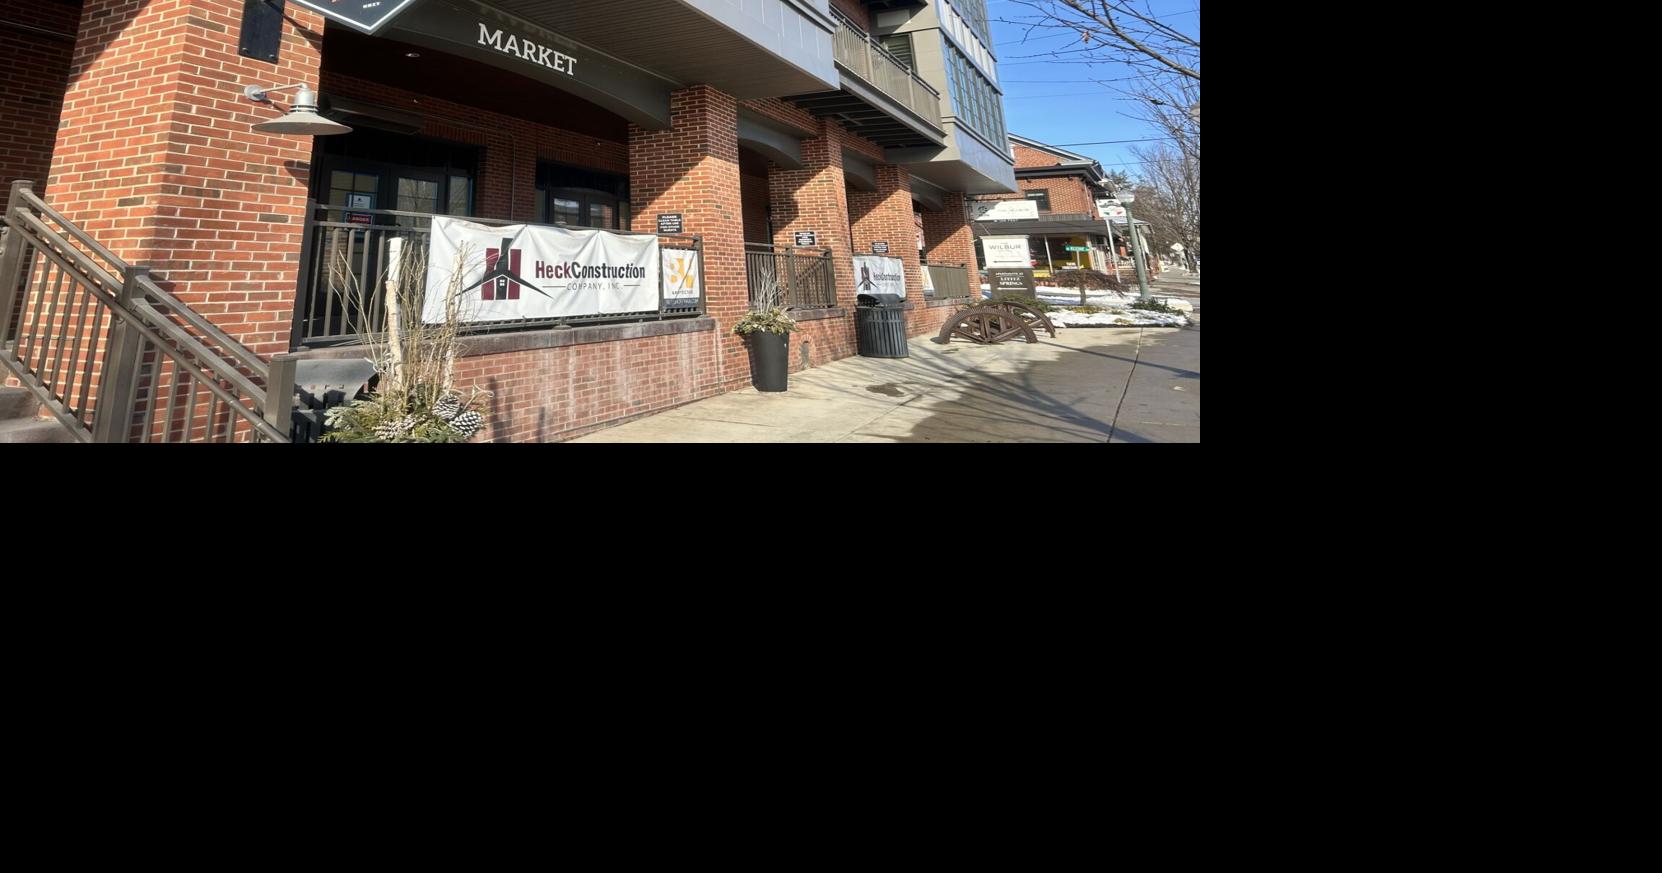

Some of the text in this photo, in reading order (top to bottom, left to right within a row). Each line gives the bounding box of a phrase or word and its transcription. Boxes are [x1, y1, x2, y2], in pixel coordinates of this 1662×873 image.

[478, 22, 578, 76] MARKET
[535, 260, 645, 279] HeckConstruction
[607, 282, 624, 290] INC.
